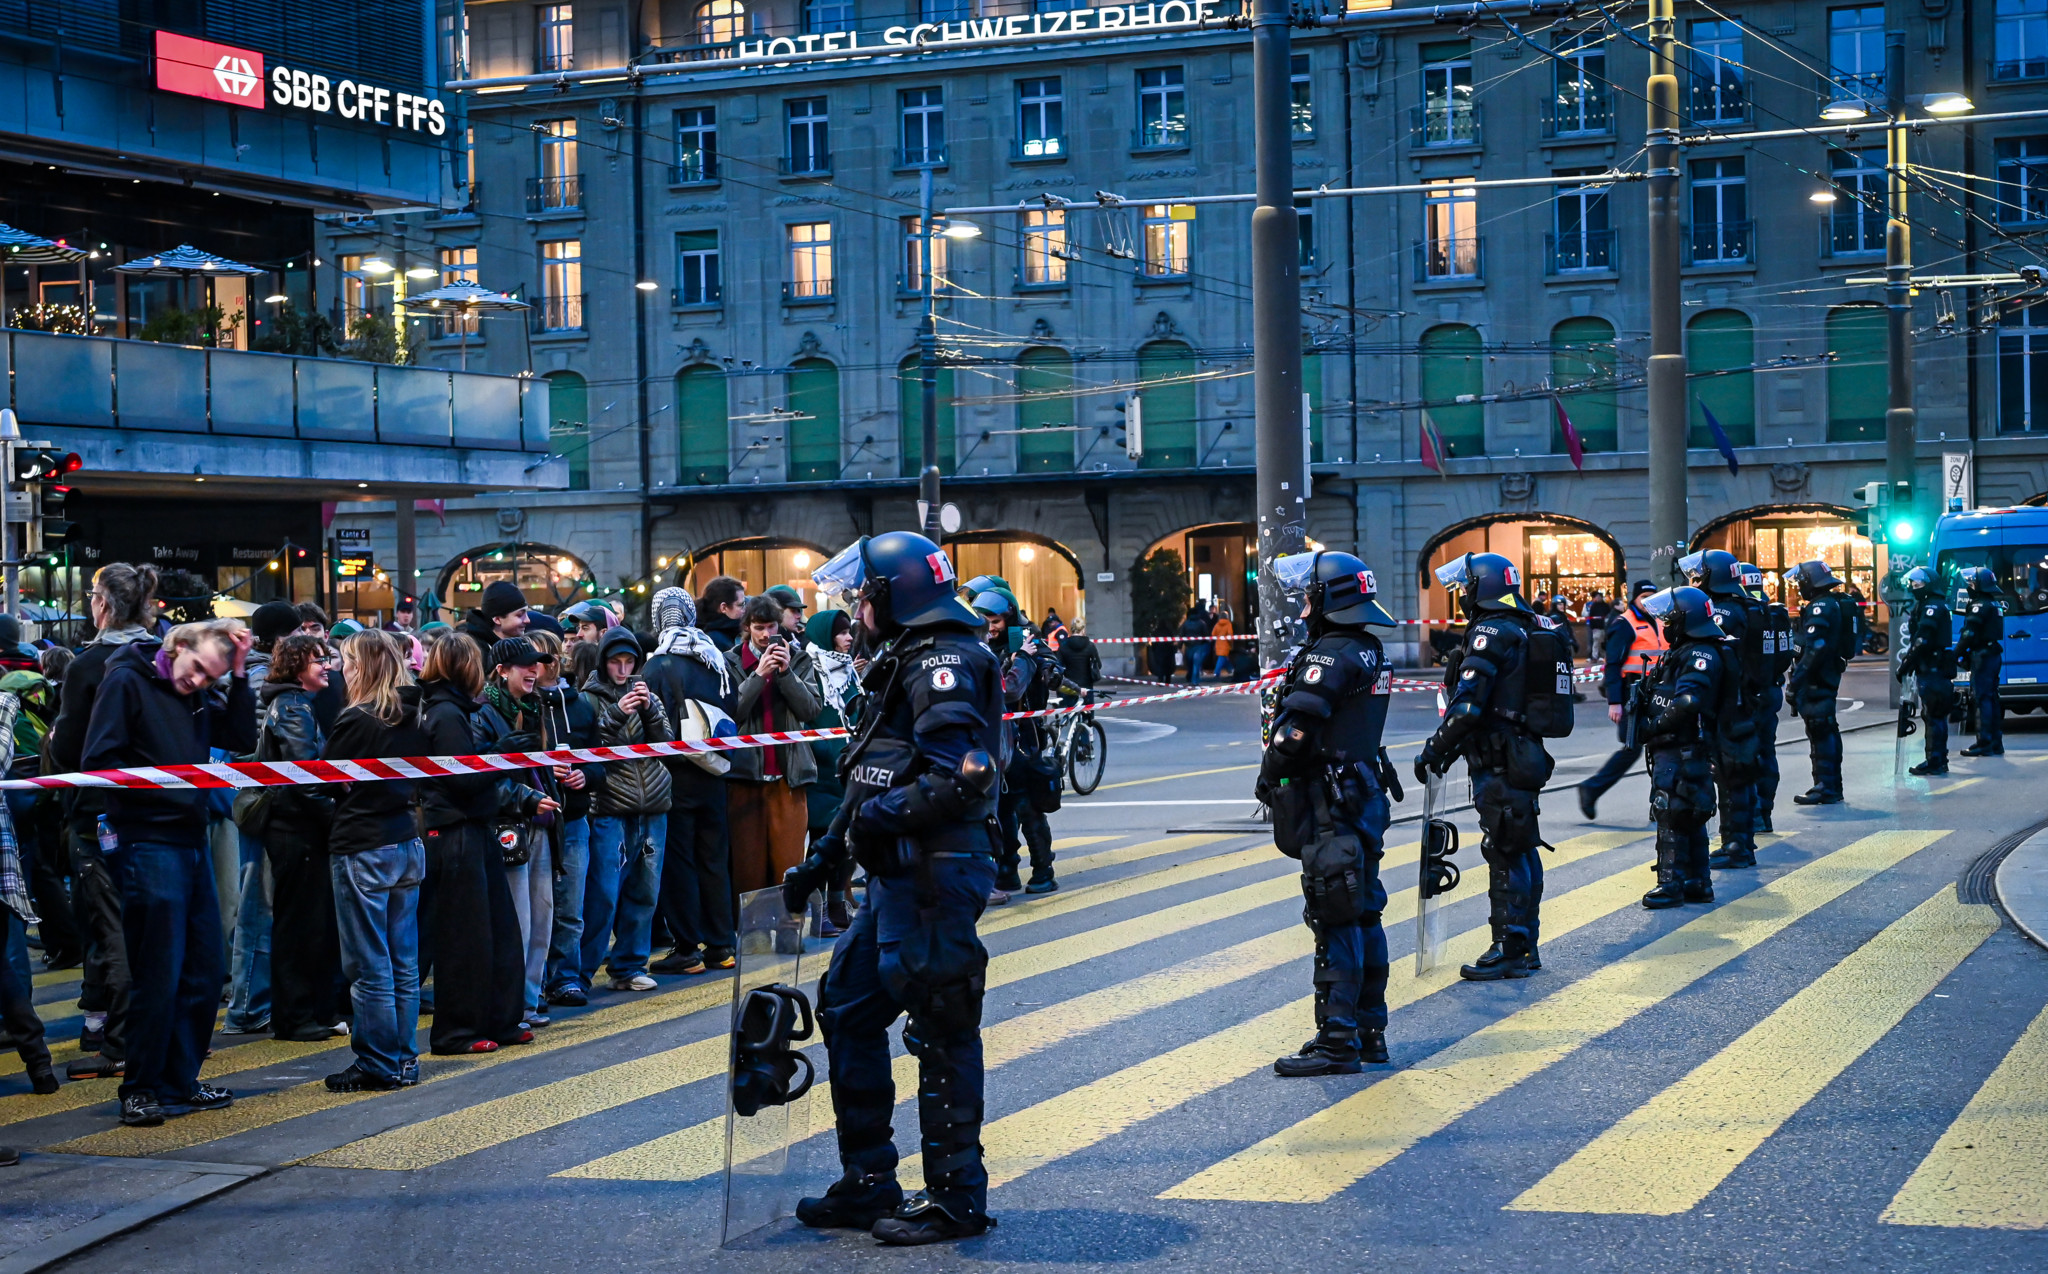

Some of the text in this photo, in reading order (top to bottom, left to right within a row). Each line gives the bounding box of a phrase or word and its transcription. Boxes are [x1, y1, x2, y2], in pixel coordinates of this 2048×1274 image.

[739, 0, 1220, 70] HOTEL SCHWEIZERHOF
[272, 66, 446, 136] SBB CFF FFS
[86, 547, 100, 558] Bar
[153, 547, 199, 561] Take Away
[233, 548, 276, 559] Restaurant
[1749, 575, 1760, 584] 12
[1475, 626, 1498, 635] POLIZEI
[1306, 654, 1335, 666] POLIZEI
[1692, 650, 1713, 661] POLIZEI
[922, 654, 961, 669] POLIZEI
[1560, 679, 1568, 689] 12
